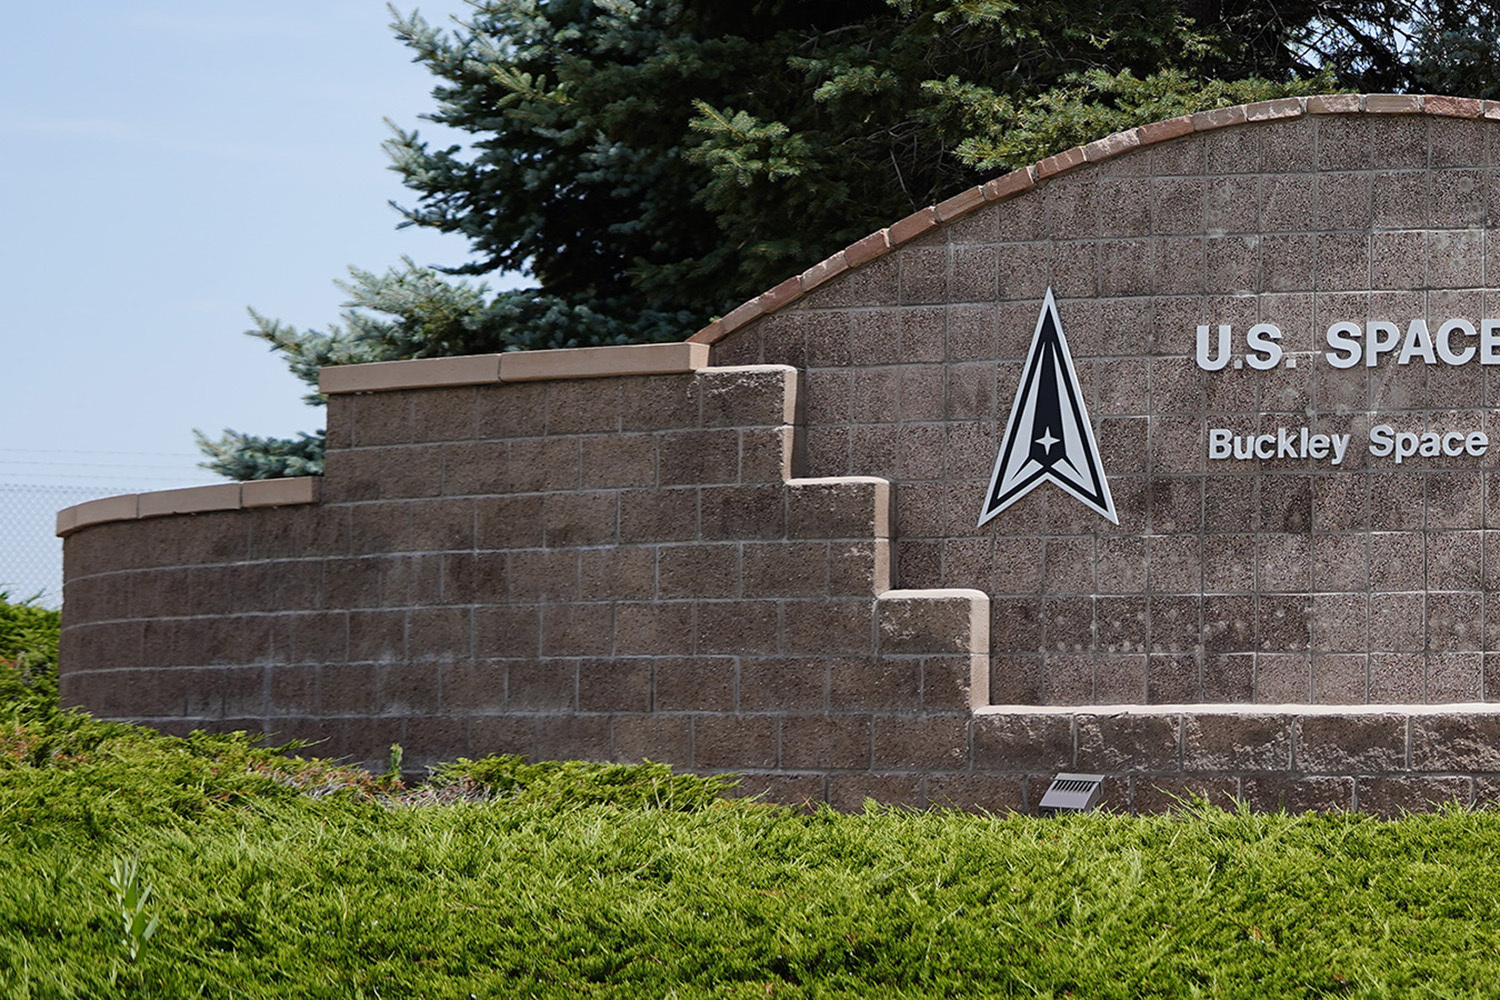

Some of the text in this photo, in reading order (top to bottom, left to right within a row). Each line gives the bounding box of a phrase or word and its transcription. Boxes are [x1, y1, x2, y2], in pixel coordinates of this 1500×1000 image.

[1197, 323, 1297, 371] U.S.
[1209, 427, 1350, 465] Buckley
[1369, 424, 1489, 464] Space
